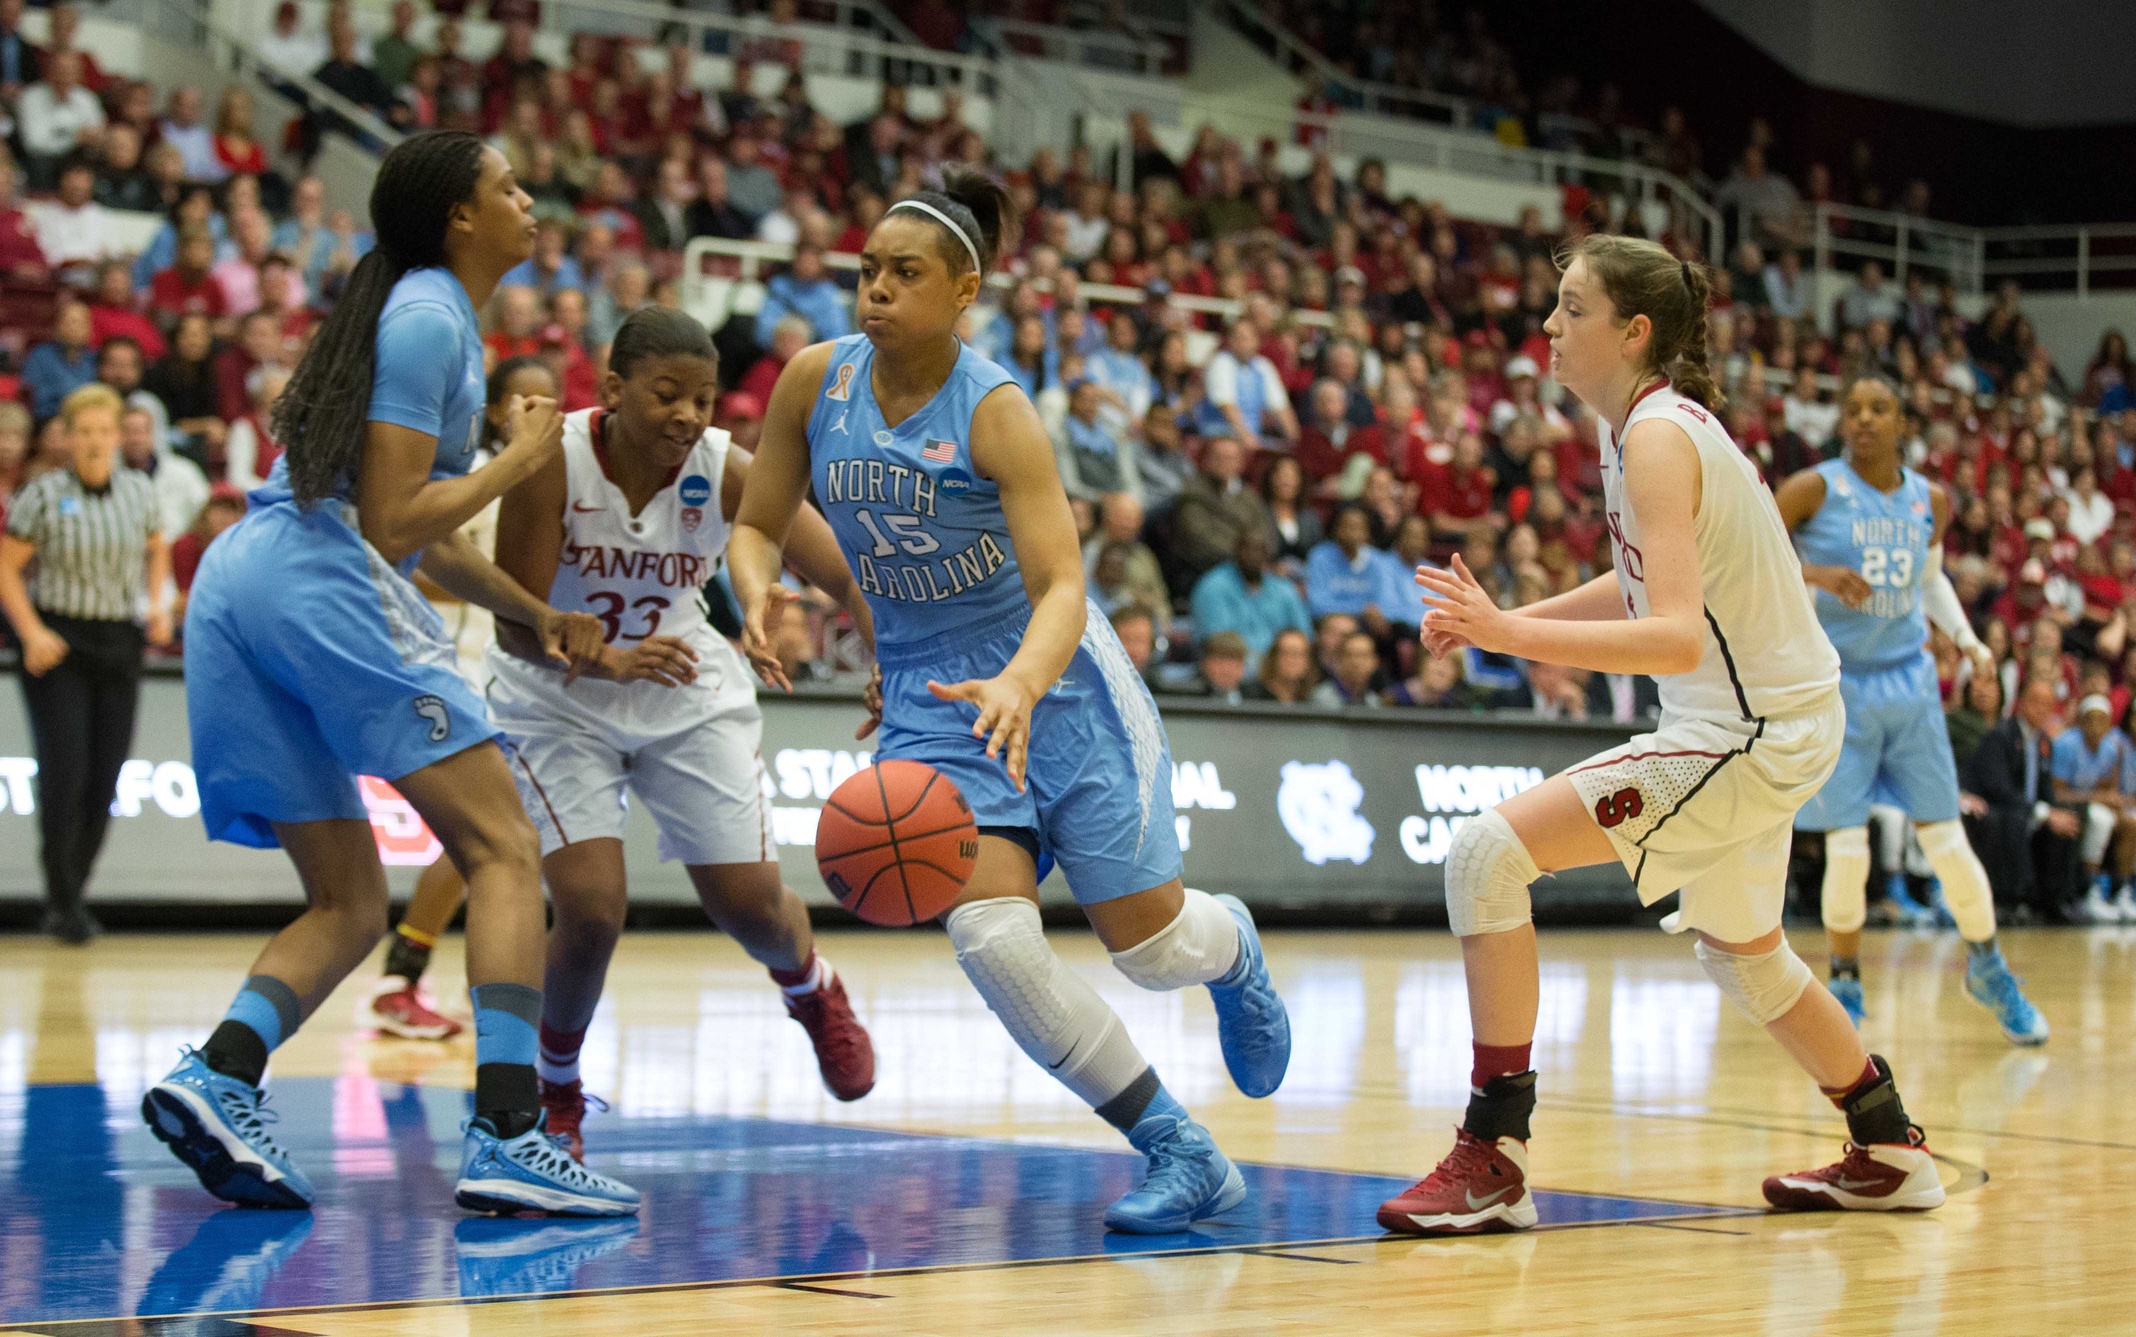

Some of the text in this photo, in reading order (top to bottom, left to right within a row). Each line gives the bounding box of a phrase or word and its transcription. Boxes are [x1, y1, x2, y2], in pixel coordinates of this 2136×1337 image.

[827, 458, 938, 518] NORTH
[942, 477, 970, 489] NCAA
[855, 508, 942, 559] 15
[1852, 517, 1921, 551] NORTH
[858, 529, 1006, 602] AROLINA
[1862, 546, 1913, 588] 23
[586, 590, 671, 643] 33
[1594, 786, 1644, 829] S
